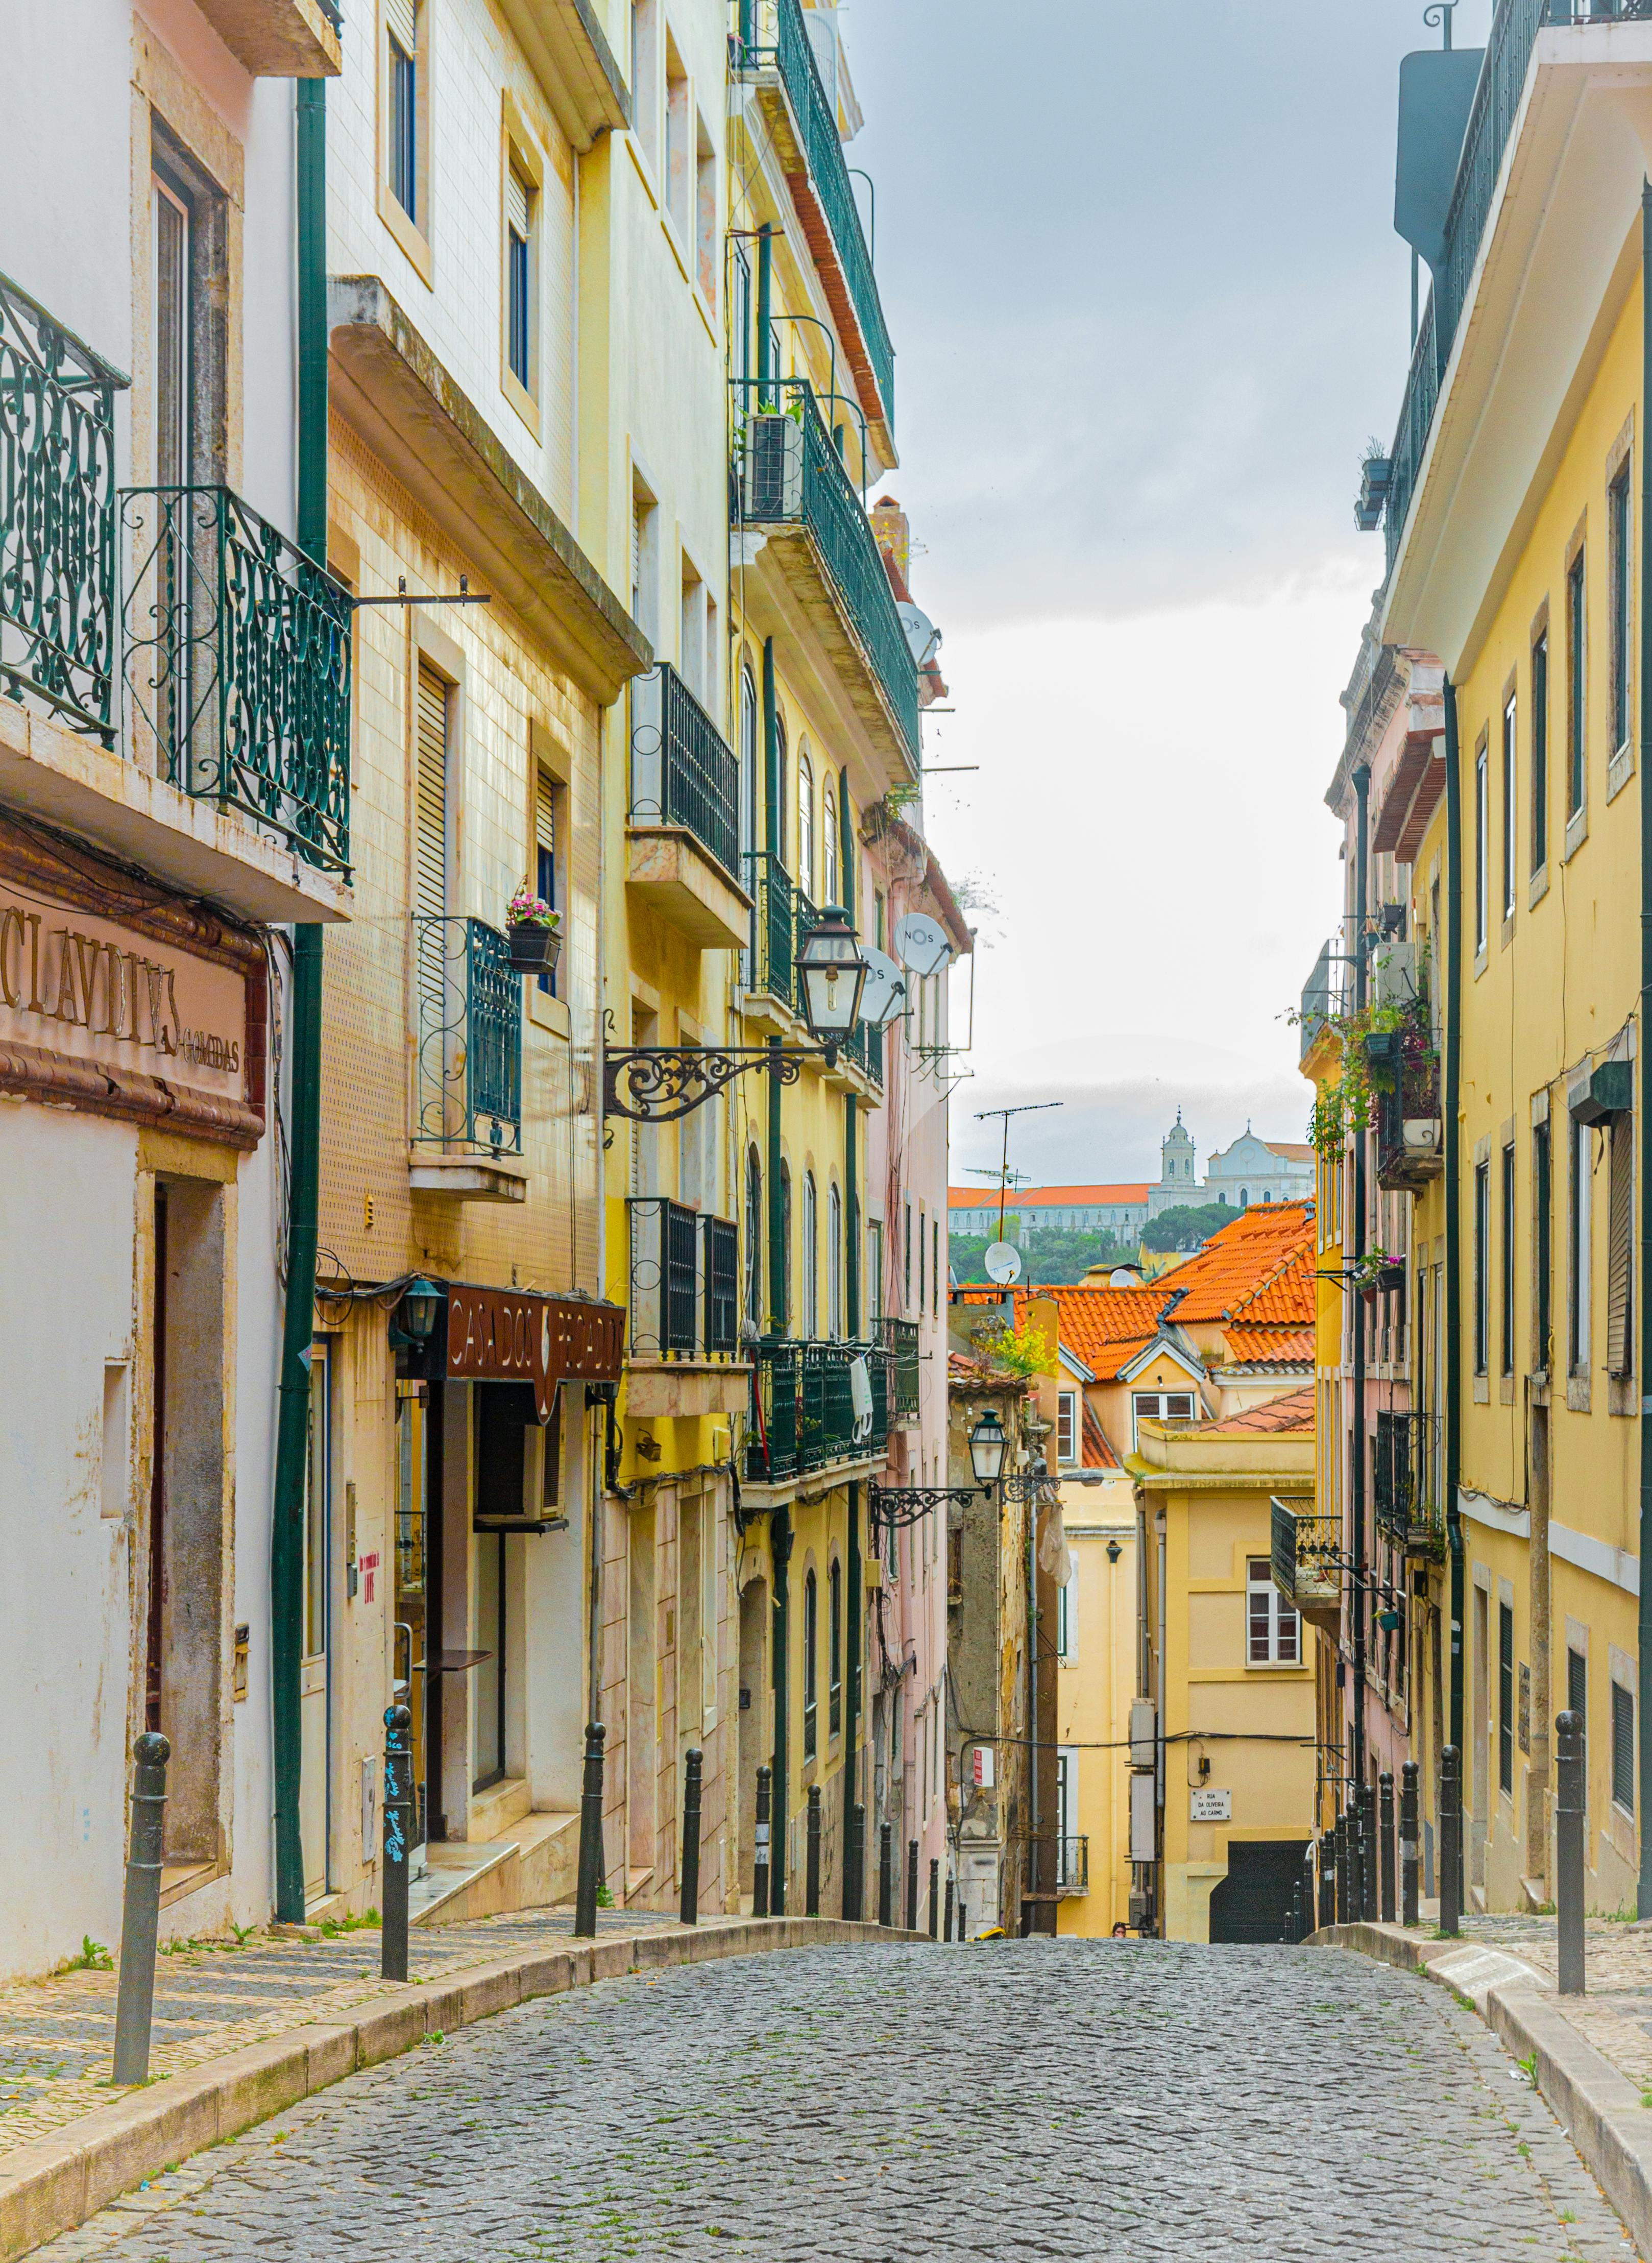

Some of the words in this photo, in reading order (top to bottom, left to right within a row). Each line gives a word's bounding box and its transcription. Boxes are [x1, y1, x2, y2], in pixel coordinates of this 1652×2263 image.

[905, 928, 934, 945] NOS
[451, 1298, 497, 1366] CASA
[502, 1306, 532, 1368] DOS
[558, 1311, 623, 1370] PECADOS
